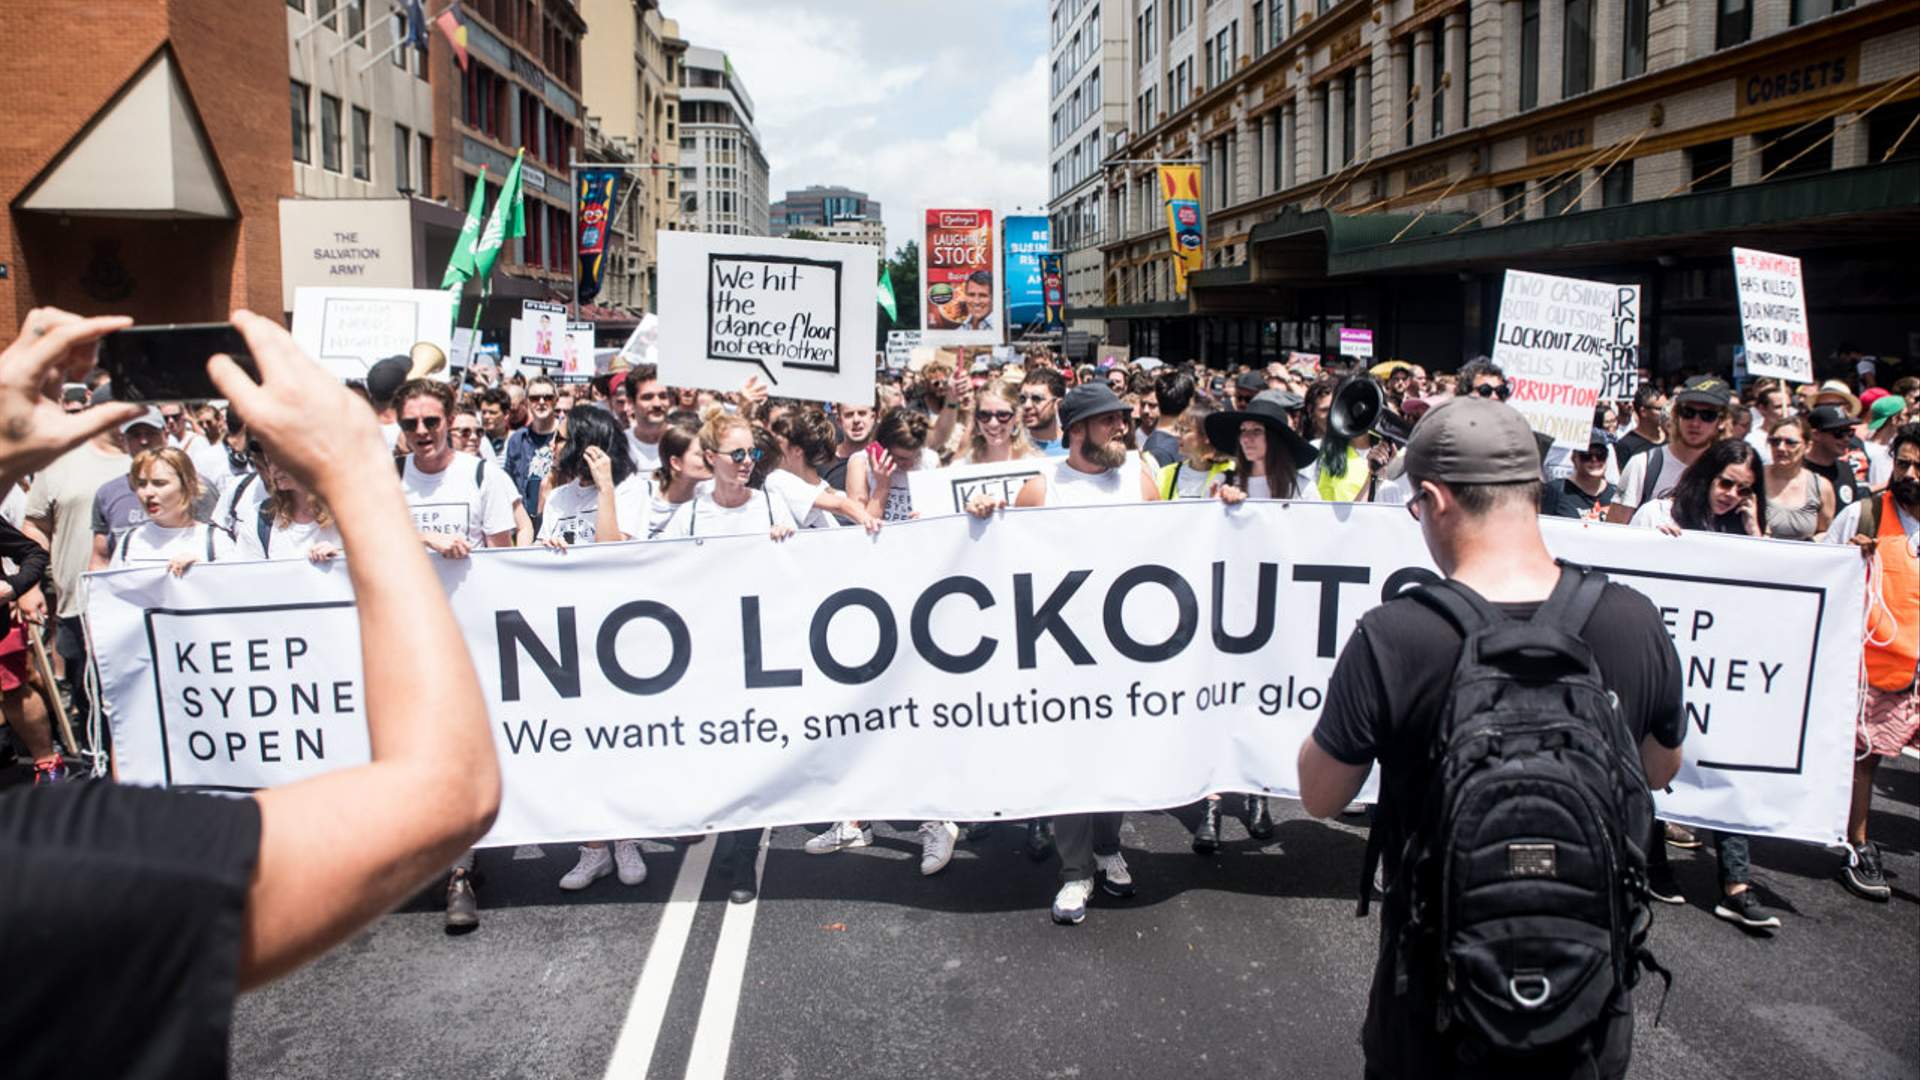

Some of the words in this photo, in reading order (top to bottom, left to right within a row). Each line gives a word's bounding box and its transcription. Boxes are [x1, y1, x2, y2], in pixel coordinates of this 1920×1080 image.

[1746, 57, 1847, 105] CORSETS
[334, 232, 359, 243] THE
[933, 233, 987, 247] LAUGHING
[1010, 243, 1048, 254] BUSIN
[314, 248, 380, 260] SALVATION
[330, 264, 365, 275] ARMY
[934, 246, 987, 265] STOCK
[715, 265, 754, 290] We
[762, 264, 804, 291] hit
[1508, 273, 1544, 298] TWO
[1550, 281, 1614, 311] CASINOS
[716, 290, 755, 316] the
[1501, 298, 1539, 322] BOTH
[1546, 305, 1609, 334] OUTSIDE
[714, 338, 743, 354] not
[1498, 322, 1573, 353] LOCKOUT
[1496, 349, 1553, 376] SMELLS
[1562, 359, 1600, 384] LIKE
[1507, 376, 1599, 408] ORRUPTION
[961, 477, 1029, 508] KEE
[1660, 606, 1714, 641] EP
[175, 637, 308, 674] KEEP
[495, 600, 691, 702] NO
[1687, 656, 1783, 694] NEY
[183, 681, 354, 718] SYDNE
[503, 719, 572, 754] We
[585, 716, 685, 749] want
[700, 708, 789, 748] safe,
[804, 697, 919, 741] smart
[933, 688, 1113, 728] solutions
[1126, 681, 1185, 717] for
[1196, 682, 1246, 711] our
[1258, 675, 1322, 716] glo
[188, 728, 324, 763] OPEN
